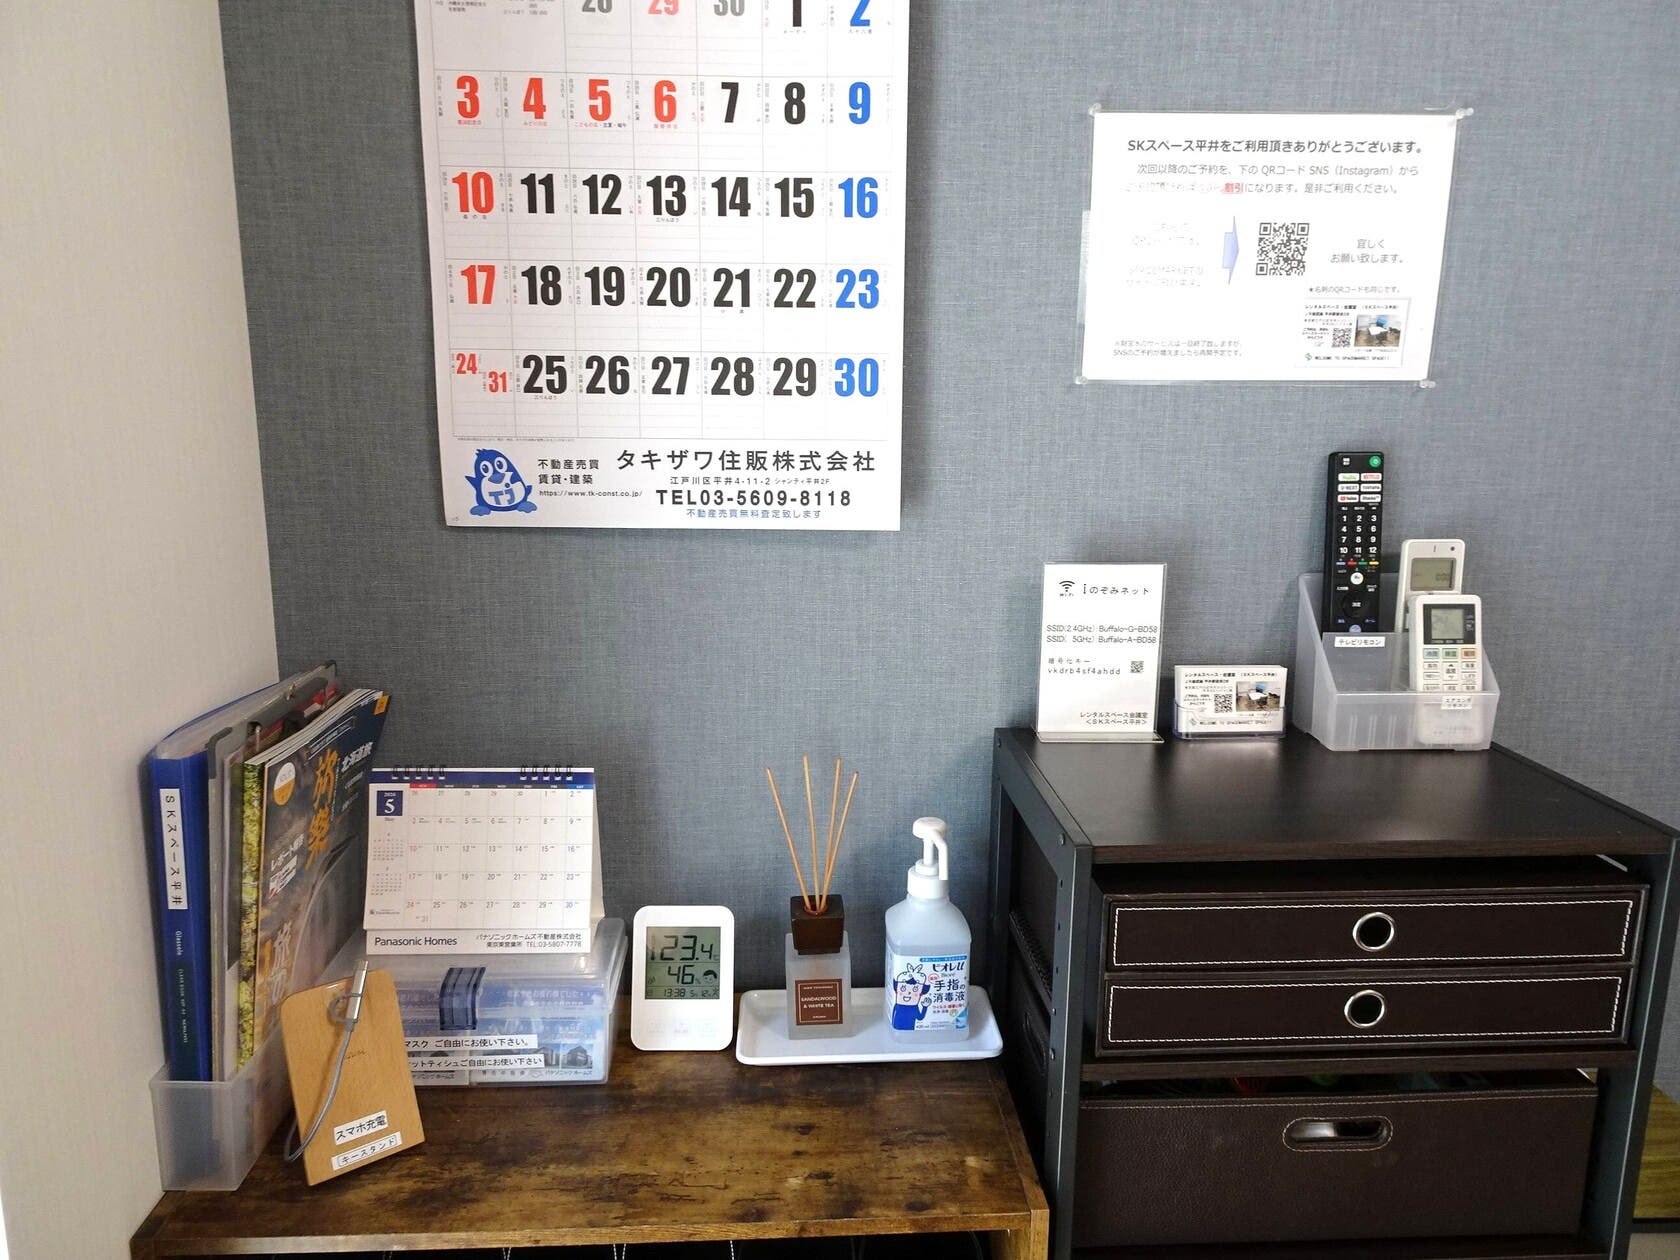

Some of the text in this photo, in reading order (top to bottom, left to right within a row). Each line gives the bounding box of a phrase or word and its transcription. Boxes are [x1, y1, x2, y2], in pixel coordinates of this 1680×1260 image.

[851, 0, 870, 26] 2
[457, 76, 479, 118] 3
[523, 78, 546, 119] 4
[589, 79, 611, 121] 5
[655, 80, 676, 122] 6
[722, 82, 738, 122] 7
[785, 82, 805, 124] 8
[849, 82, 870, 124] 9
[1127, 139, 1422, 154] SKスペース平井をご利用頂きありがとうございます。
[452, 172, 494, 213] 10
[521, 173, 554, 213] 11
[583, 174, 621, 214] 12
[647, 175, 686, 216] 13
[712, 177, 750, 216] 14
[775, 178, 814, 218] 15
[839, 177, 878, 218] 16
[1357, 238, 1385, 248] 宜しく
[461, 265, 879, 308] 17 18 19 20 21 22 23
[456, 353, 477, 374] 24
[489, 371, 506, 392] 31
[523, 355, 878, 396] 25 26 27 28 29 30
[537, 459, 600, 470] 不動産売買
[617, 449, 876, 471] タキザワ住販株式会社
[538, 474, 594, 485] 賃貸・建築
[670, 476, 771, 486] 江戸川区平井4-11-2
[539, 489, 643, 498] https://www.tk-const.co.jp/
[655, 489, 851, 506] TEL03-5609-8118
[686, 508, 822, 519] 不動産売買無料査定致します
[1339, 546, 1348, 554] 10
[1368, 546, 1377, 554] 12
[384, 798, 395, 814] 5
[165, 795, 183, 906] SKスペース平井
[374, 937, 457, 946] Panasonic Homes
[667, 964, 695, 985] 46
[934, 979, 966, 991] 手指の
[933, 991, 965, 1003] 消毒液
[435, 1037, 529, 1048] ご自由にお使い下さい。
[336, 1114, 386, 1141] スマホ充電
[342, 1138, 395, 1164] キースタンド
